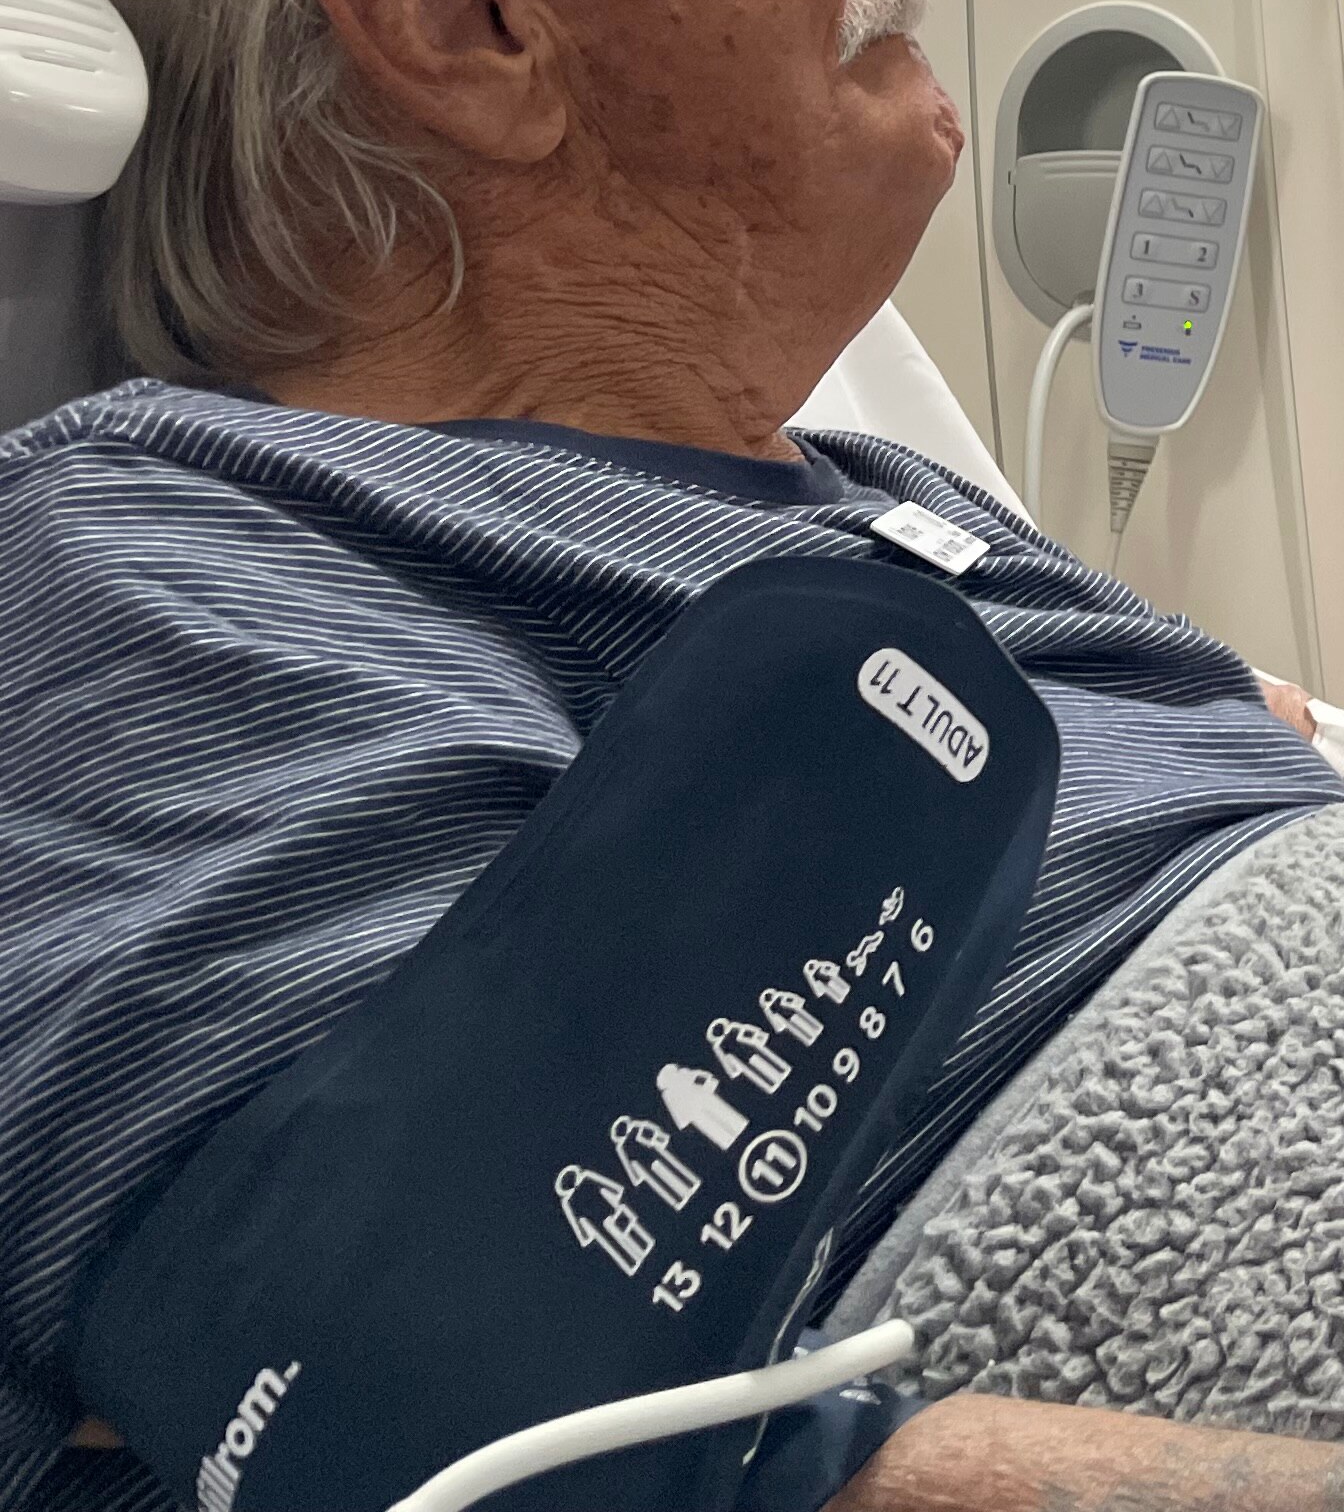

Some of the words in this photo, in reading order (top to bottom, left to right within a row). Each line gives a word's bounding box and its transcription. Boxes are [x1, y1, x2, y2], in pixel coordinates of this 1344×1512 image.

[1143, 240, 1150, 255] 1
[1197, 247, 1207, 262] 2
[1189, 290, 1200, 306] S
[870, 660, 900, 694] 11
[896, 685, 984, 769] ADULT
[652, 1260, 701, 1313] 13
[700, 1201, 754, 1252] 12
[751, 1142, 797, 1187] 11
[793, 1084, 838, 1132] 10
[832, 1047, 861, 1083] 9
[859, 1006, 887, 1040] 8
[882, 961, 905, 997] 7
[911, 918, 935, 952] 6
